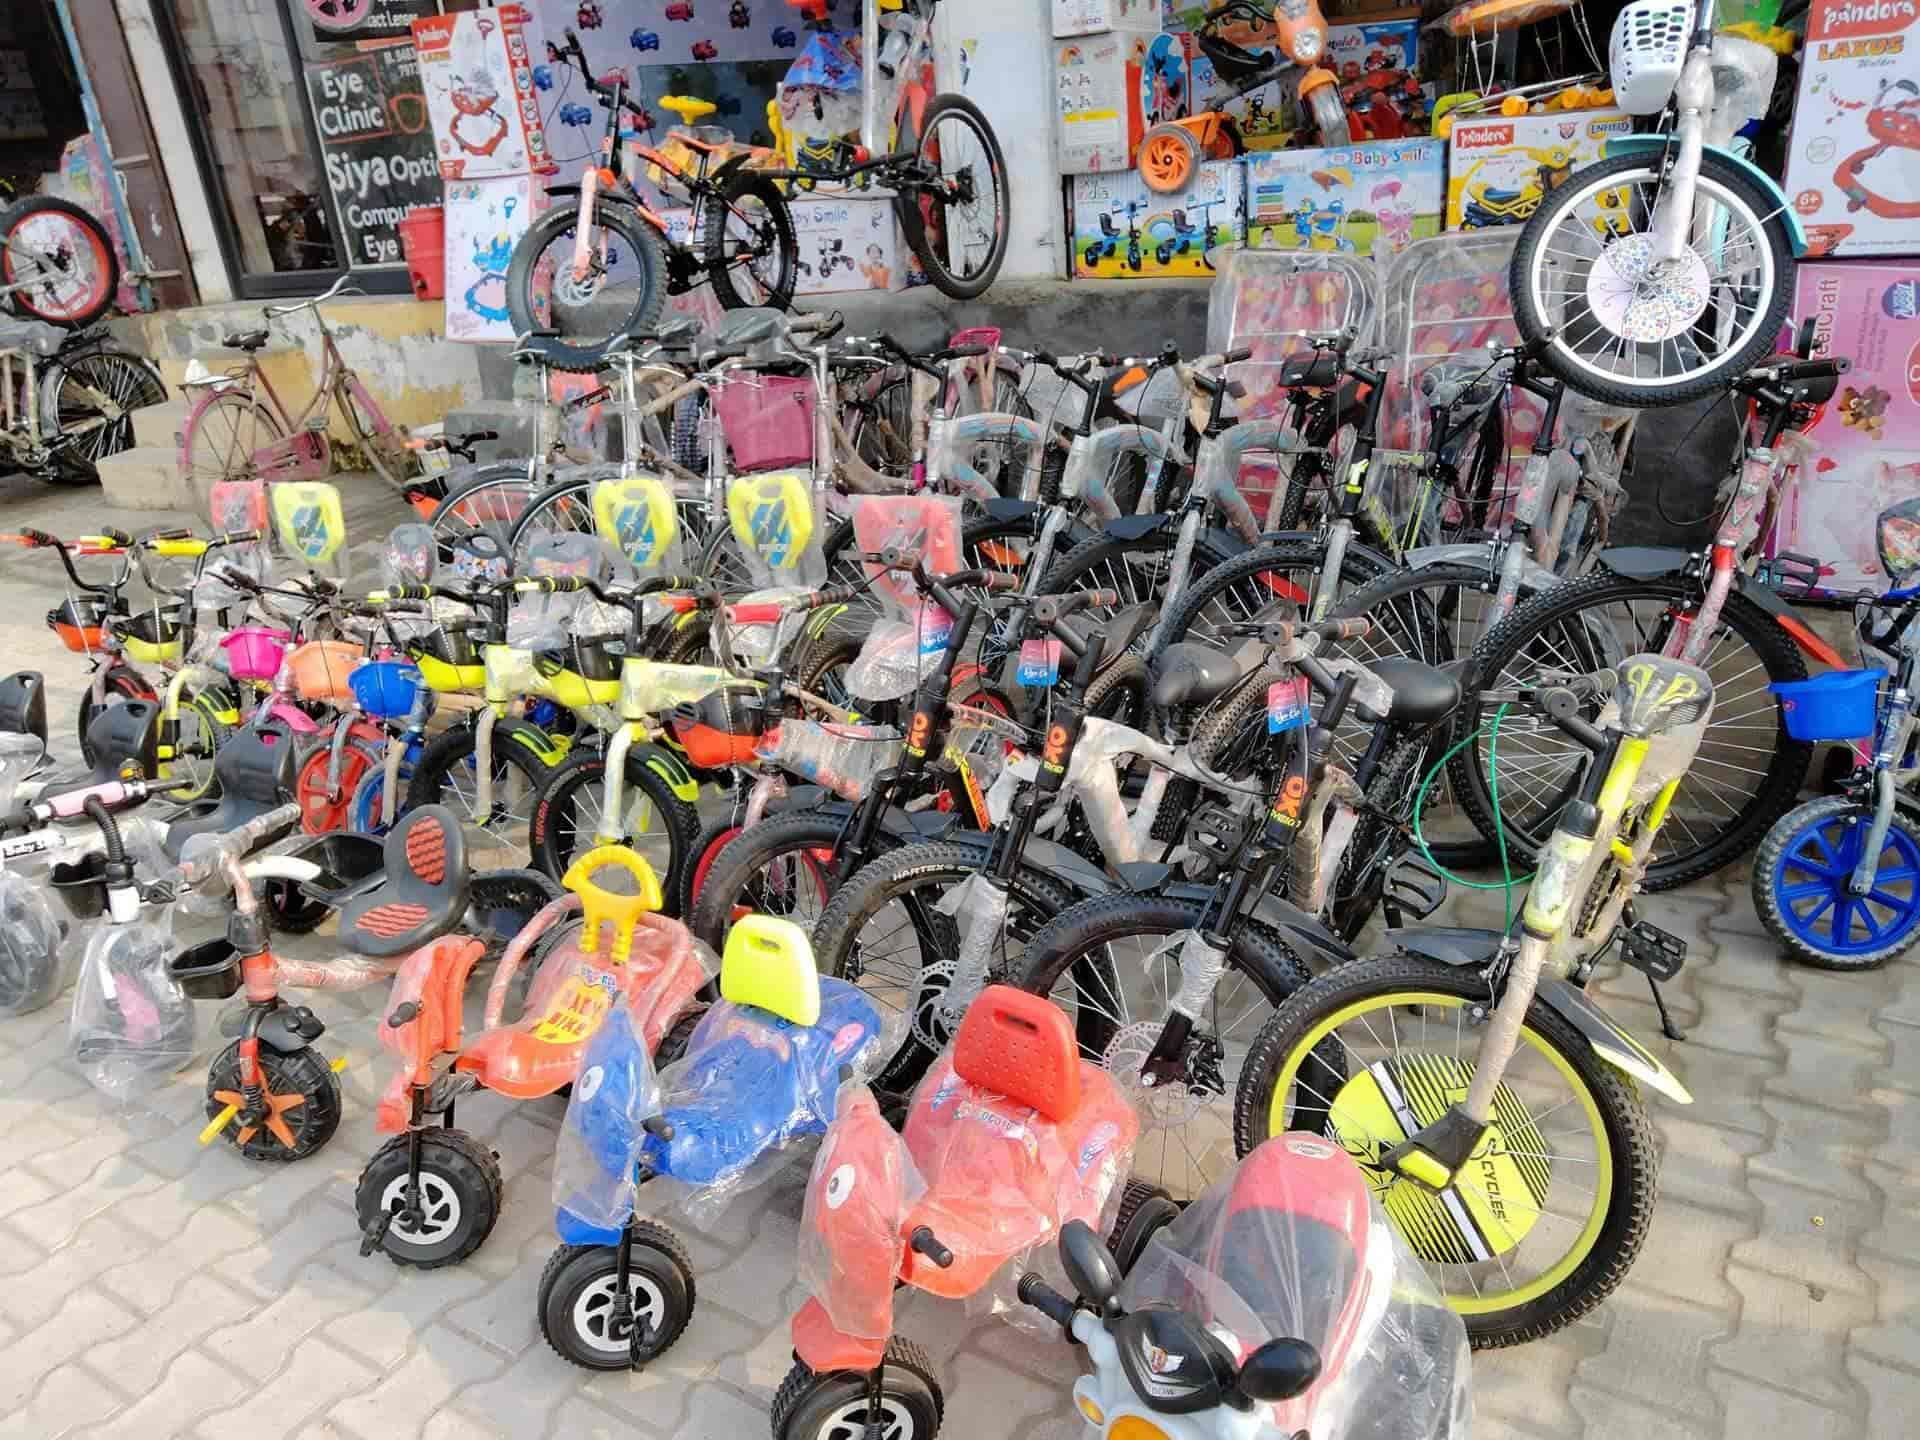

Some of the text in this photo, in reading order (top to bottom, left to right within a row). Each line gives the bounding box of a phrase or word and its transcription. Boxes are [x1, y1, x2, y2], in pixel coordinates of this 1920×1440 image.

[320, 69, 364, 102] Eye
[320, 103, 384, 136] Clinic
[1353, 150, 1389, 168] Baby
[327, 151, 442, 198] Siya Opti
[814, 206, 849, 224] Smile
[363, 235, 398, 262] Eye
